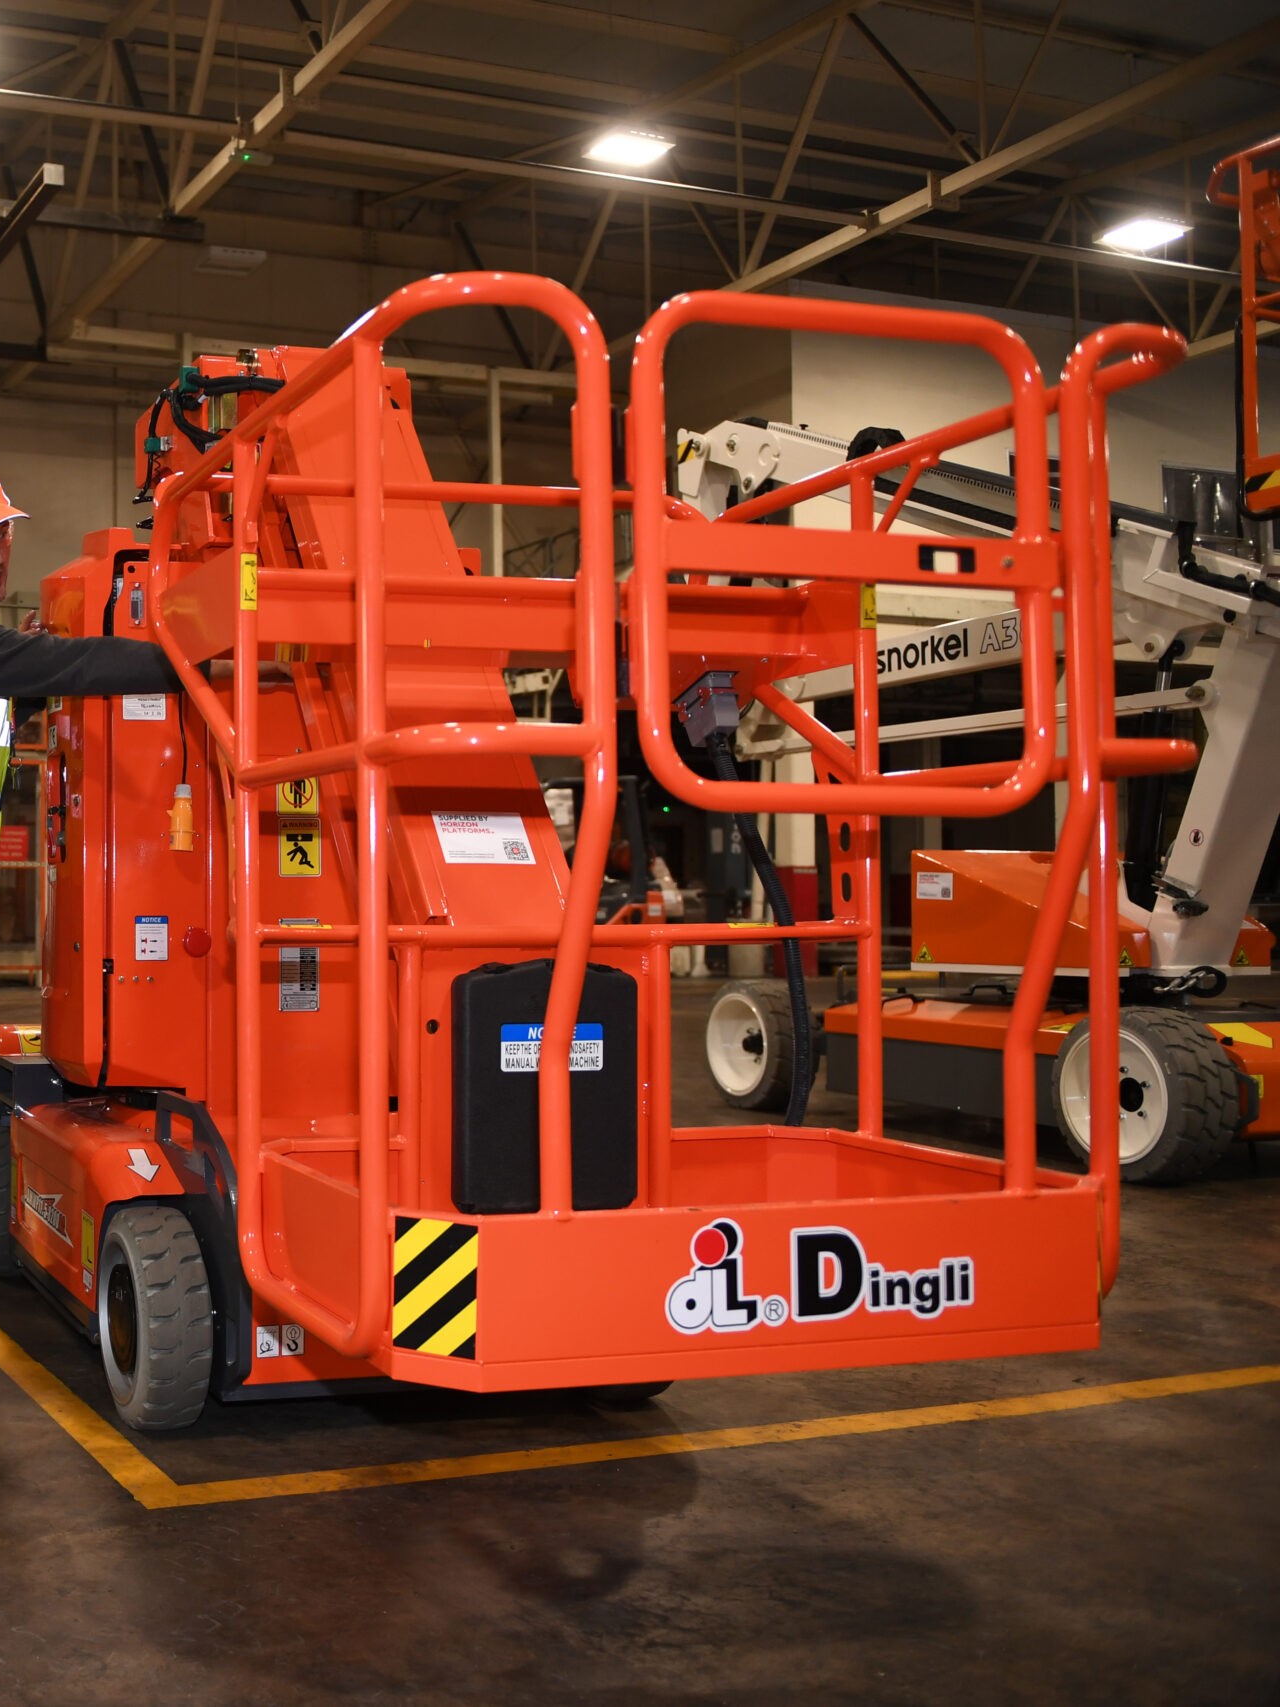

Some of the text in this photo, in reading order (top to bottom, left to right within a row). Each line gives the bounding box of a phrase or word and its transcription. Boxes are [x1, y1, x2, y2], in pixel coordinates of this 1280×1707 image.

[877, 617, 1024, 674] snorkel A3
[438, 814, 476, 822] SUPPLIED
[505, 1057, 534, 1069] MANUAL
[569, 1056, 600, 1068] MACHINE
[794, 1230, 971, 1318] Dingli
